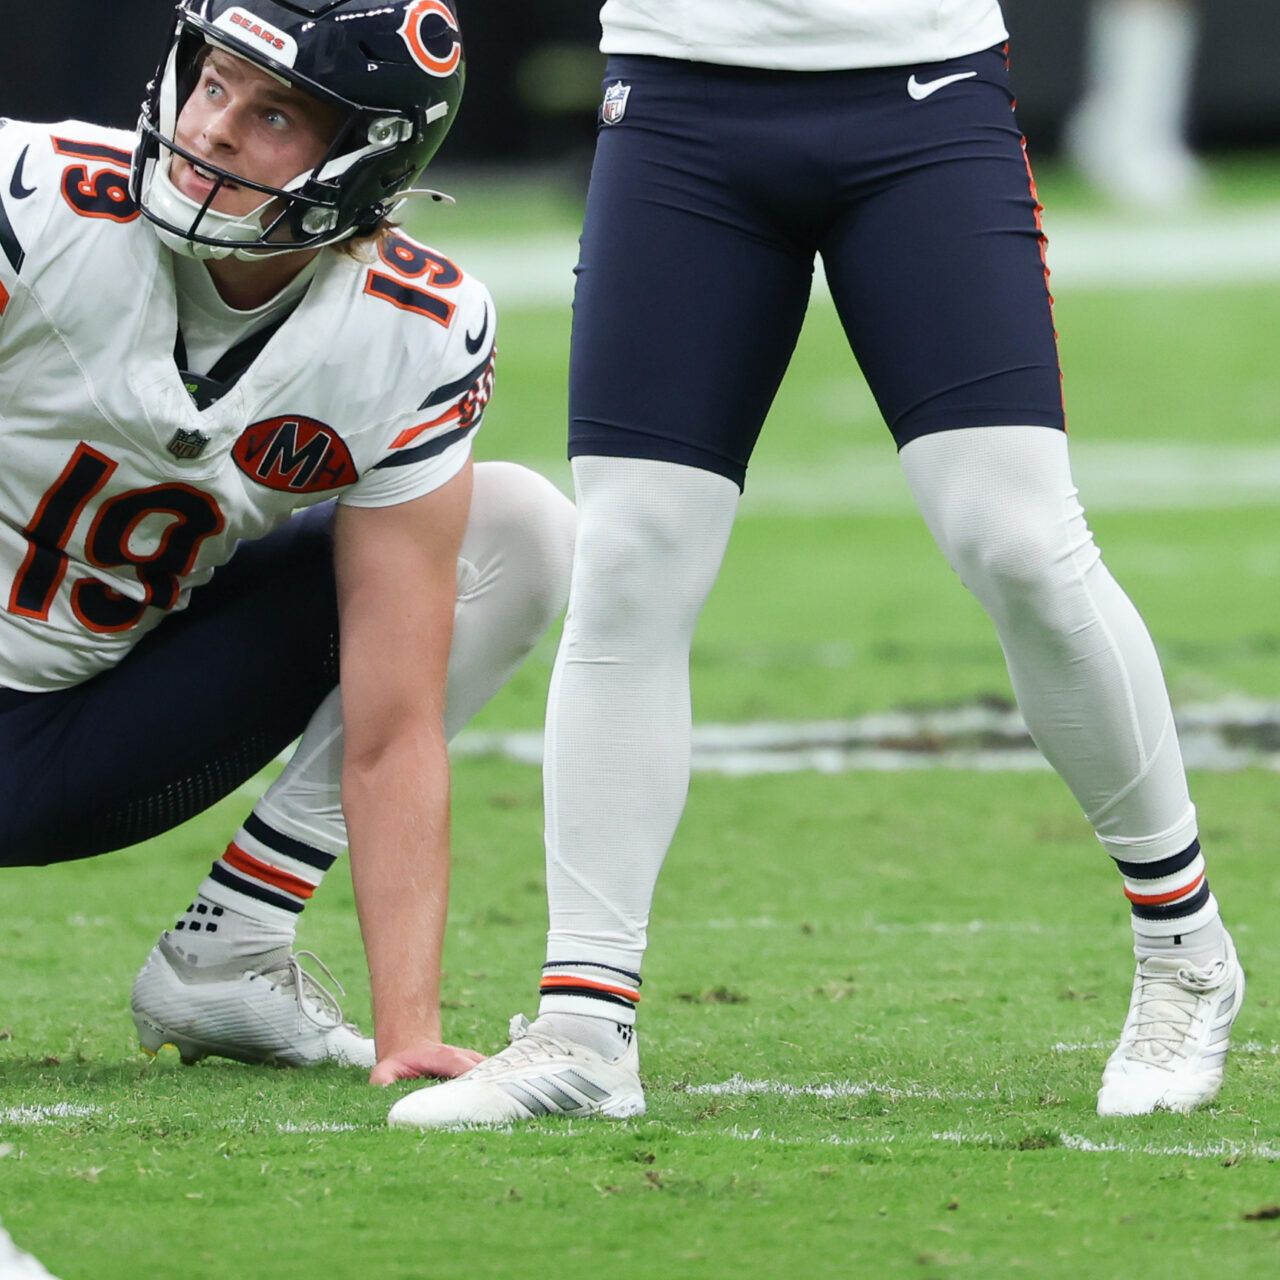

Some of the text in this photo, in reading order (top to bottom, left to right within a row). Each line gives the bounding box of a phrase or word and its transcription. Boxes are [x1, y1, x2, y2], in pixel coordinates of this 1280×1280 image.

[229, 12, 286, 51] BEARS
[49, 134, 141, 224] 19
[363, 228, 464, 329] 19
[7, 441, 225, 634] 19
